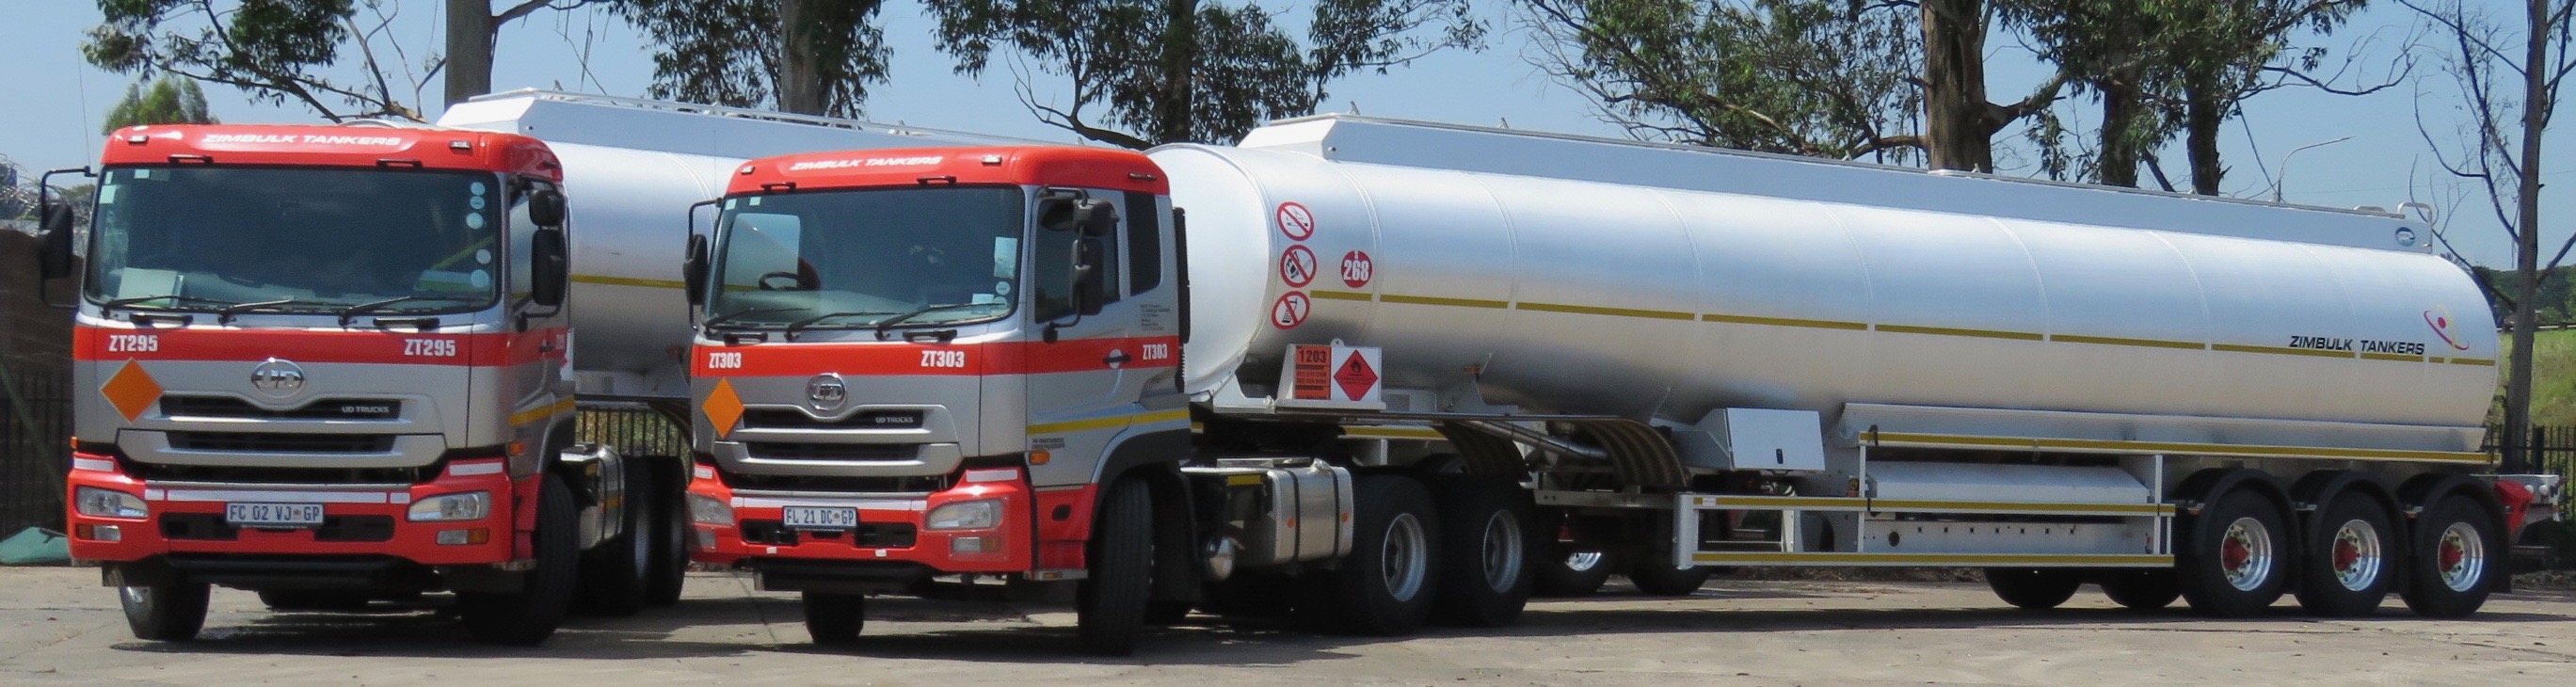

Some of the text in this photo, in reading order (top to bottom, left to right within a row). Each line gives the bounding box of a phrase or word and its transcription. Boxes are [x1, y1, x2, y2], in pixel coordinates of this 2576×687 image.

[202, 134, 402, 146] ZIMBULK TANKERS
[790, 156, 943, 170] ZIMBULK TANKERS
[1343, 259, 1369, 281] 268
[108, 334, 158, 352] ZT295
[404, 339, 456, 357] ZT295
[2289, 335, 2425, 356] ZIMBULK TANKERS
[920, 350, 965, 368] ZT303
[1142, 344, 1168, 359] ZT303
[1299, 349, 1326, 363] 1203
[709, 352, 742, 369] ZT303
[229, 505, 320, 521] FC 02 VJ GP
[786, 509, 854, 525] FL 21 DC GP
